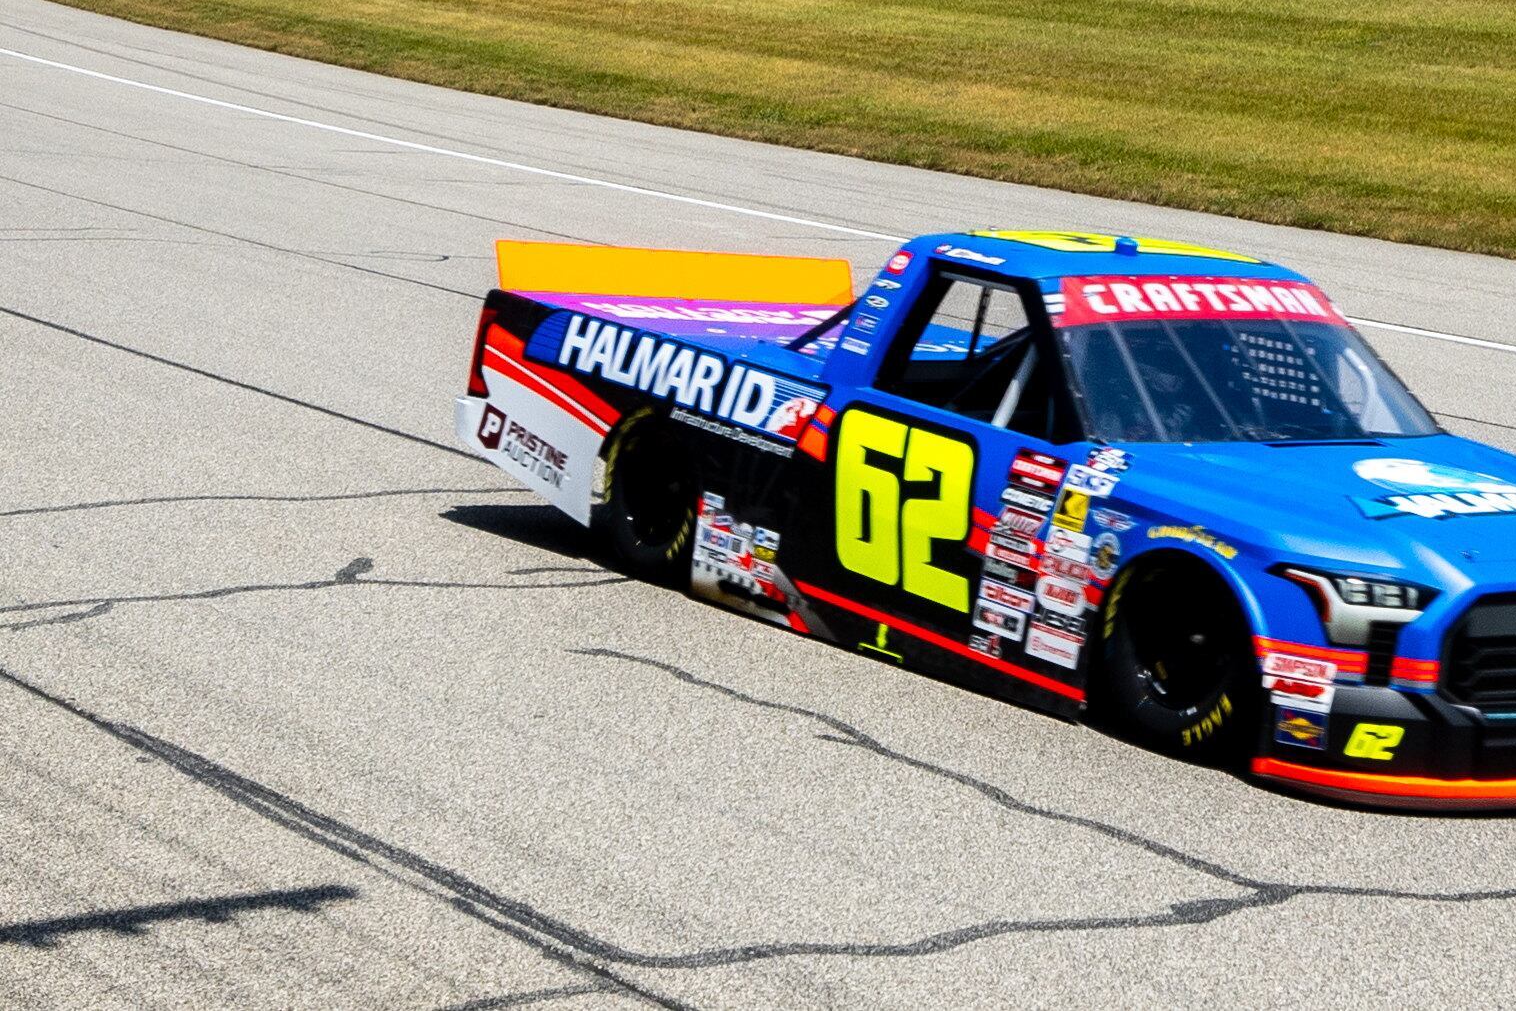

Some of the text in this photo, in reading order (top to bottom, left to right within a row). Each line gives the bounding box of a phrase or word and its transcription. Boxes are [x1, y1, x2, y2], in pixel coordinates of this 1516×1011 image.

[1083, 282, 1328, 317] CRAFTSMAN
[558, 314, 777, 427] HALMAR ID
[501, 440, 563, 489] AUCTION
[506, 420, 568, 471] PRISTINE
[835, 408, 974, 614] 62
[1343, 722, 1406, 761] 62
